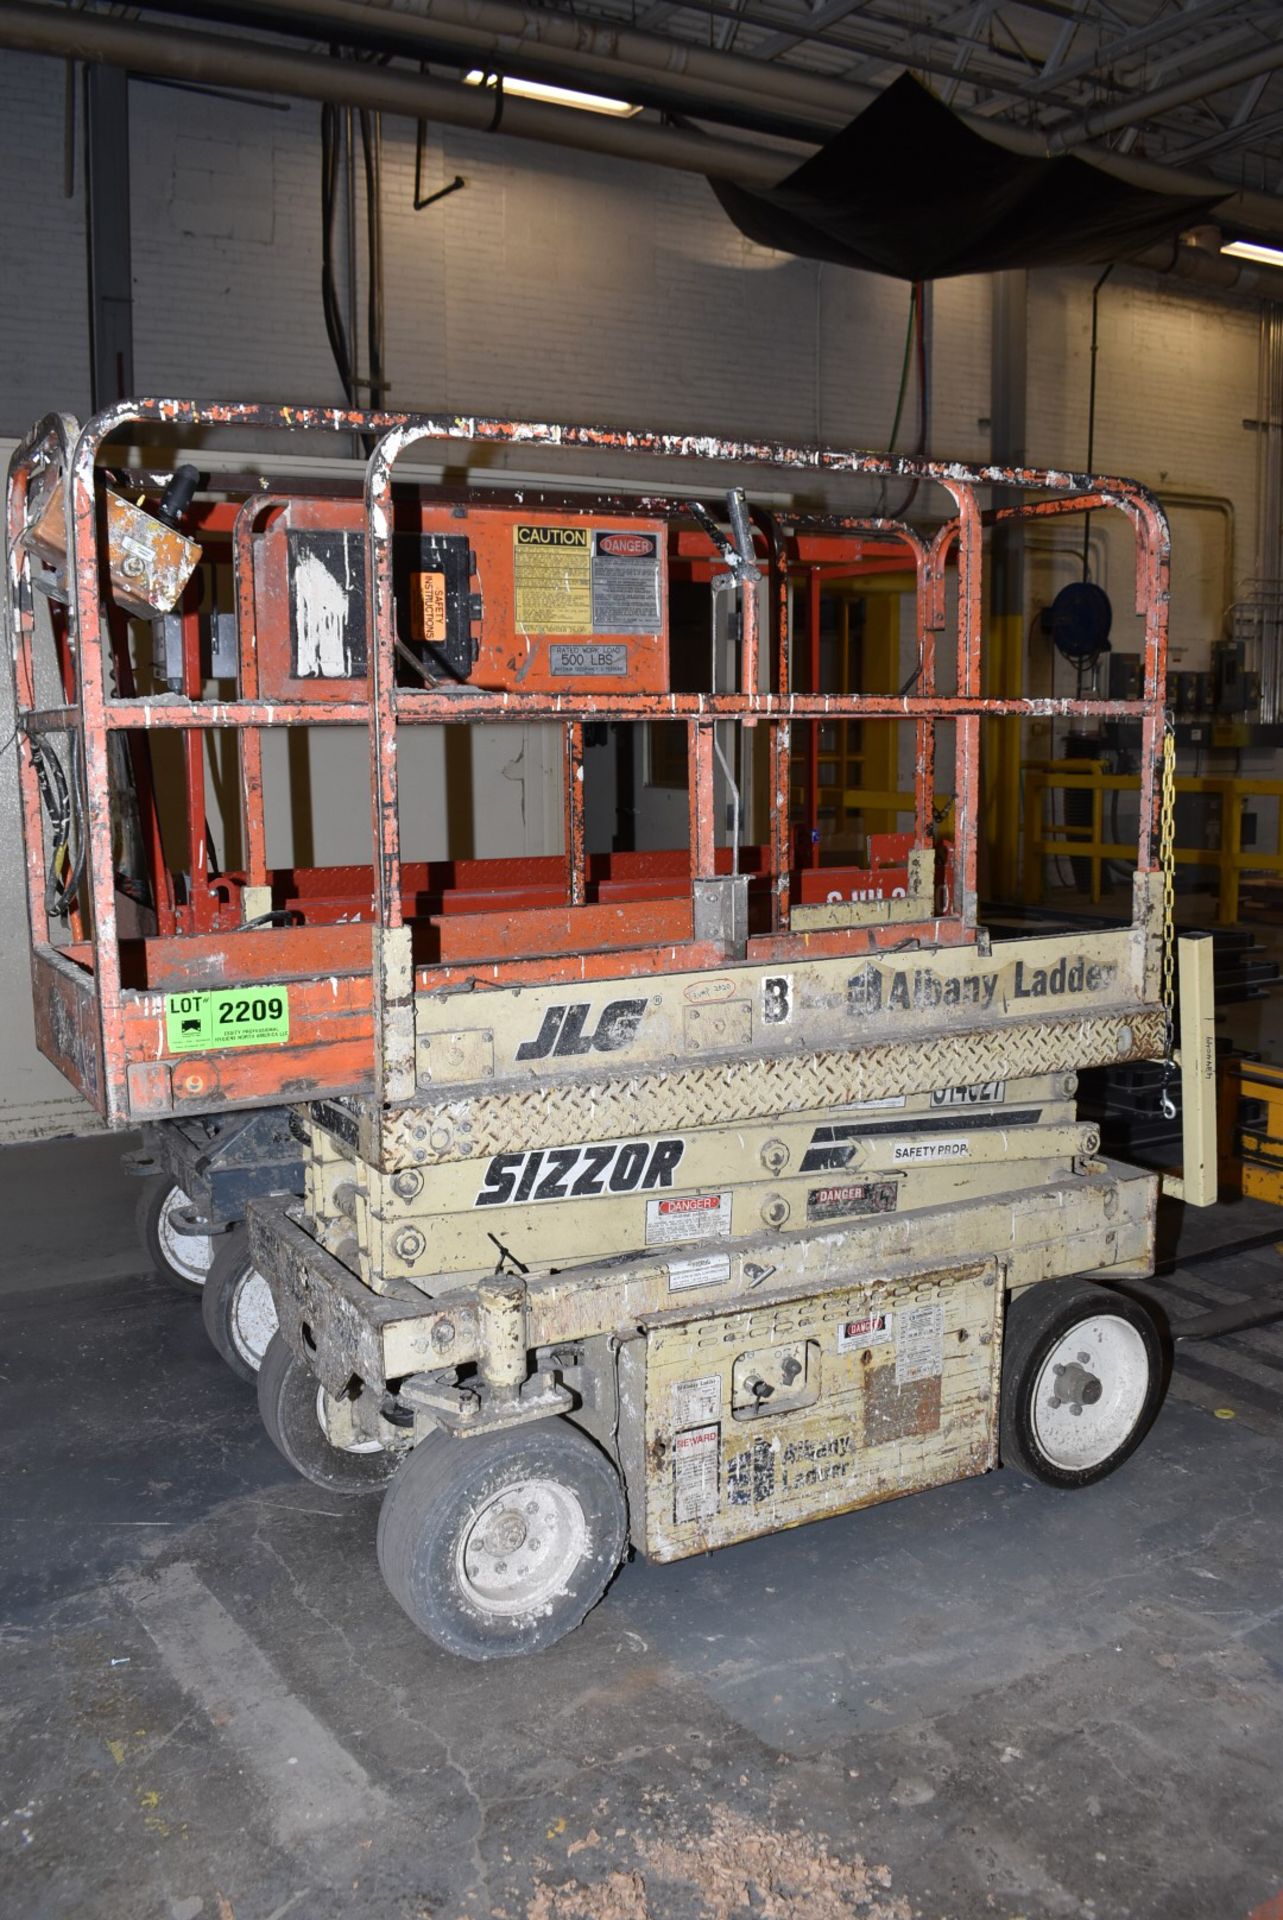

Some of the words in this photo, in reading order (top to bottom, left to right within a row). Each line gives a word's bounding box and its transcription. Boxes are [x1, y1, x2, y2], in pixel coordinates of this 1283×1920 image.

[518, 527, 586, 545] CAUTION
[604, 539, 650, 552] DANGER
[424, 575, 435, 639] INSTRUCTIONS
[434, 590, 444, 625] SAFETY
[561, 654, 584, 666] 500
[591, 654, 613, 666] LBS
[765, 978, 789, 1024] B
[890, 968, 998, 1011] Albany
[1014, 956, 1118, 999] Ladder
[219, 997, 283, 1024] 2209
[514, 998, 649, 1061] JLG
[895, 1145, 936, 1159] SAFETY
[474, 1139, 684, 1206] SIZZOR
[819, 1187, 863, 1202] DANGER
[668, 1198, 712, 1213] DANGER
[676, 1431, 717, 1449] REWARD
